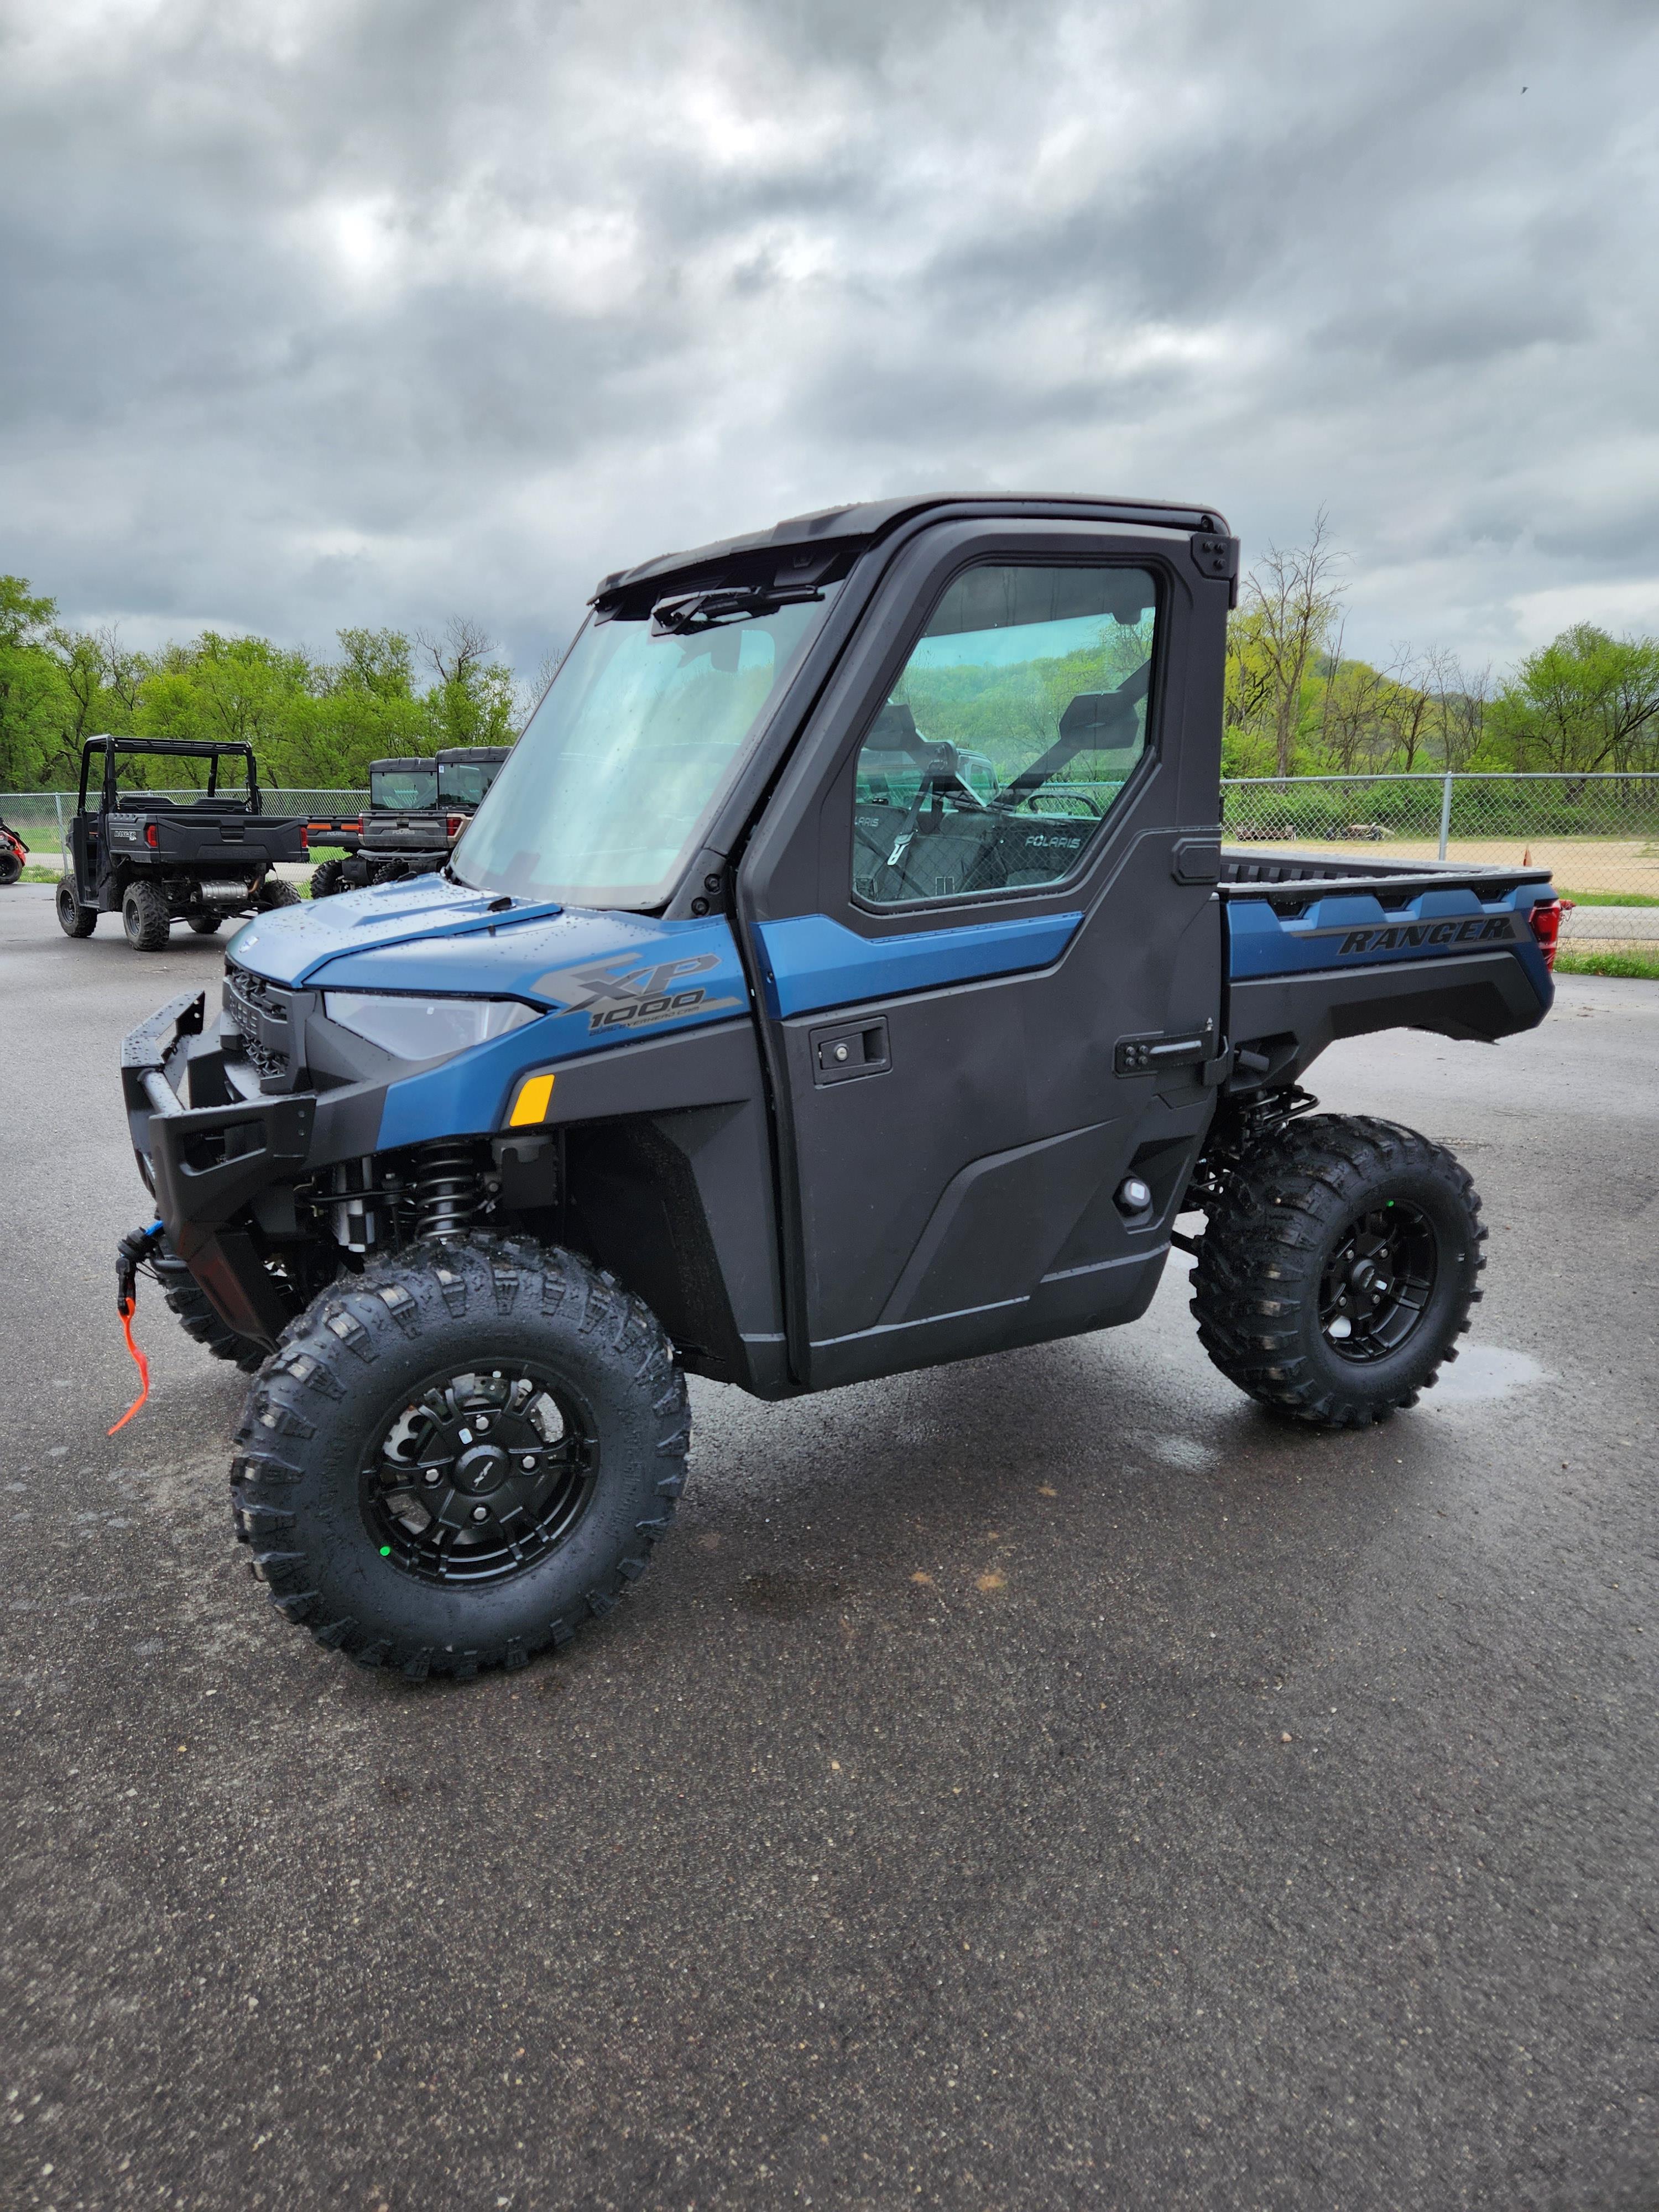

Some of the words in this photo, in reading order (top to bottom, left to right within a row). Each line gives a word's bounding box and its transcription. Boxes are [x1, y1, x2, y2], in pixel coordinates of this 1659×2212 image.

[1025, 835, 1081, 849] POLARIS
[1337, 917, 1517, 956] RANGER
[557, 953, 722, 1016] XP
[590, 989, 705, 1029] 1000
